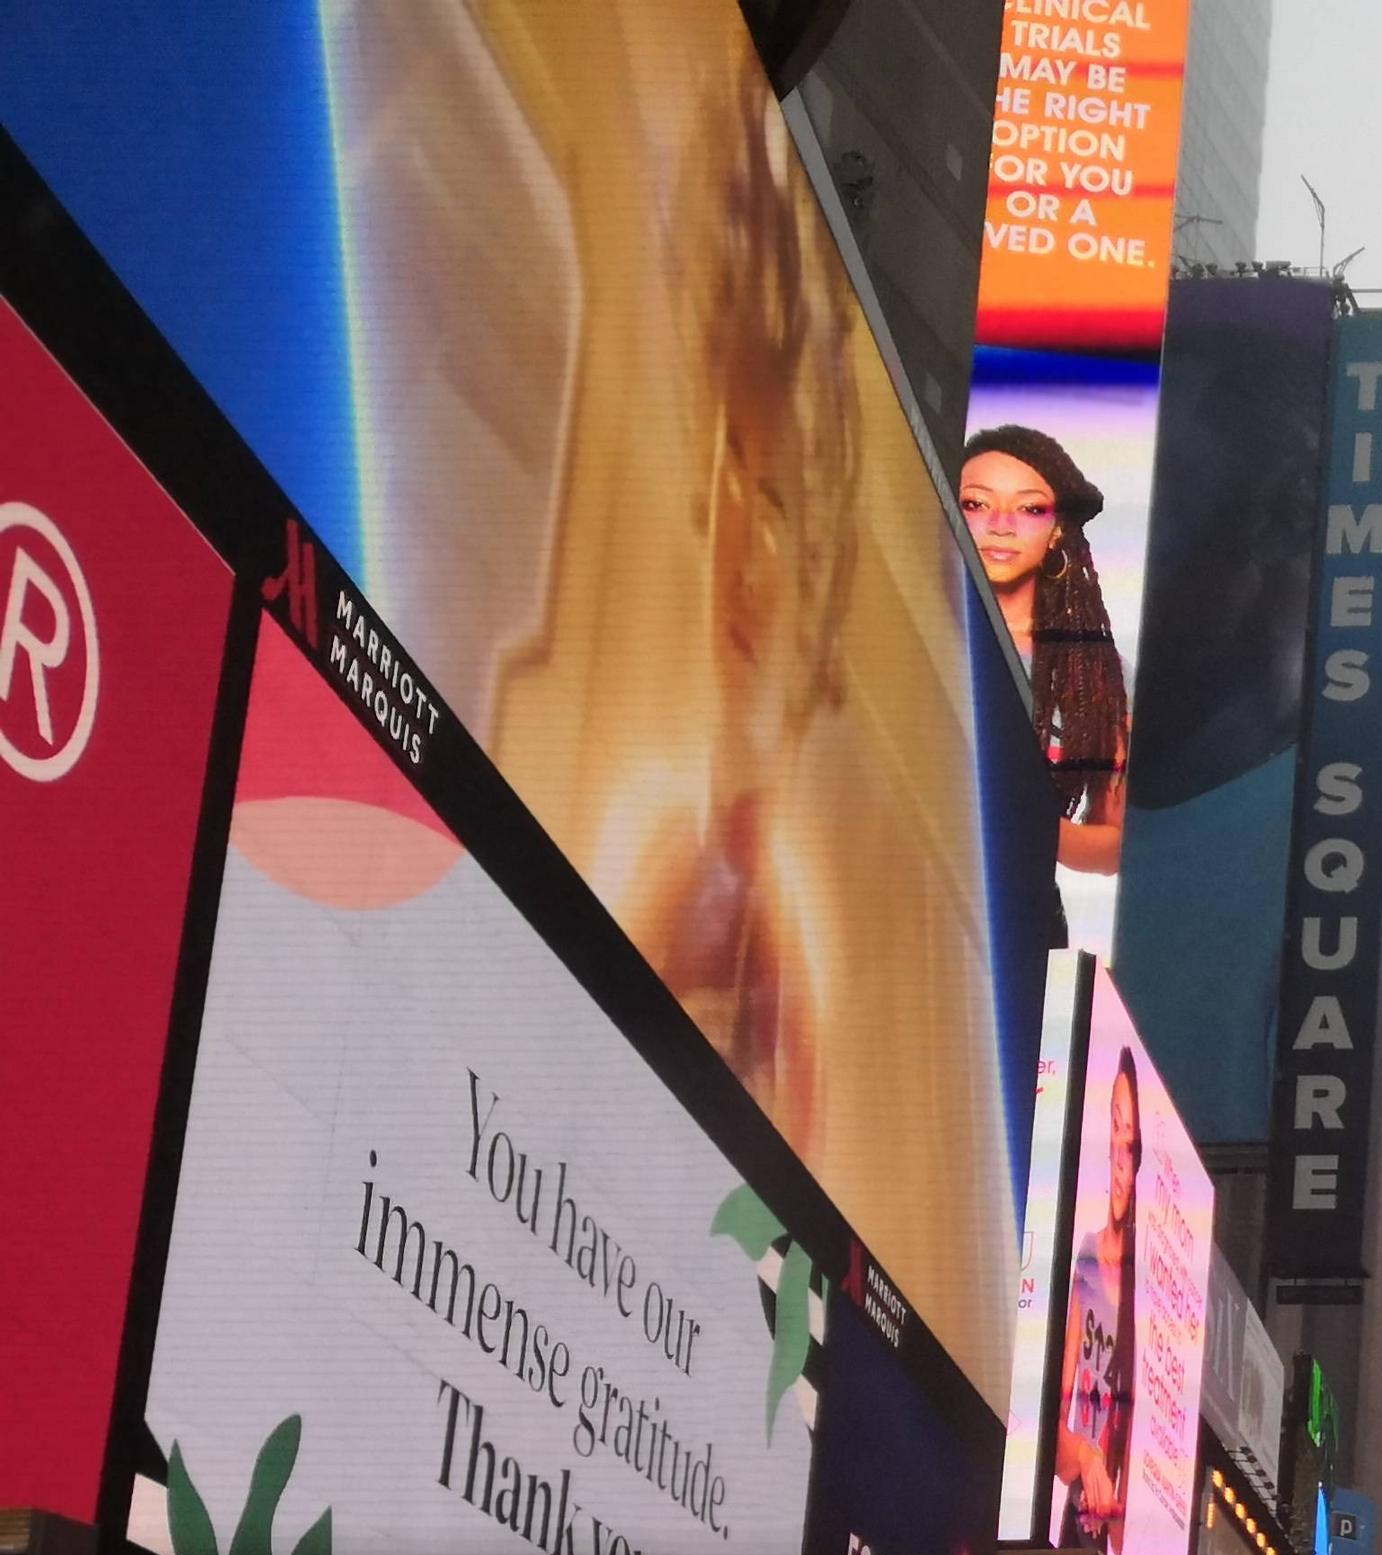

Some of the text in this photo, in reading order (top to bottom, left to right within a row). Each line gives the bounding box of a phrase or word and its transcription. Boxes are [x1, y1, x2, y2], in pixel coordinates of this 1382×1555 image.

[1004, 0, 1151, 30] LINICAL
[1012, 20, 1121, 58] TRIALS
[1000, 53, 1126, 94] MAY BE
[1044, 93, 1151, 130] RIGHT
[992, 120, 1125, 161] OPTION
[990, 154, 1133, 198] OR YOU
[1006, 190, 1097, 226] OR A
[1067, 233, 1156, 269] ONE.
[335, 590, 439, 735] MARRIOTT
[330, 636, 423, 765] MARQUIS
[1292, 763, 1364, 1211] SQUARE
[464, 1067, 702, 1378] You have our
[866, 1263, 907, 1324] MARRIOTT
[864, 1291, 900, 1349] MARQUIS
[353, 1149, 732, 1541] immense gratitude.
